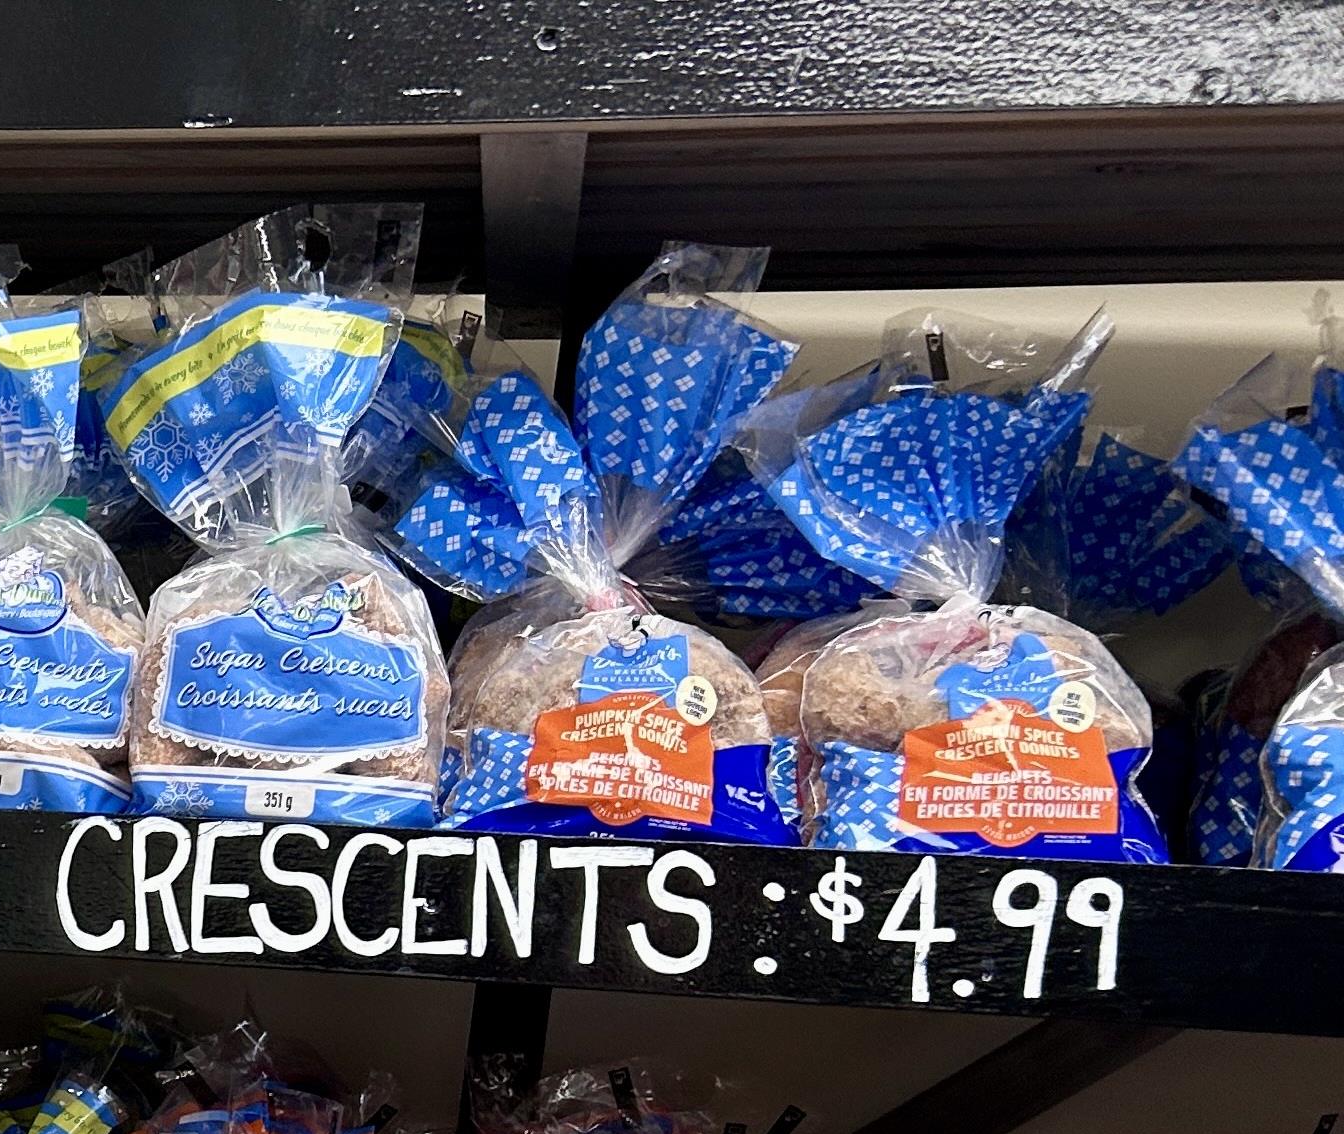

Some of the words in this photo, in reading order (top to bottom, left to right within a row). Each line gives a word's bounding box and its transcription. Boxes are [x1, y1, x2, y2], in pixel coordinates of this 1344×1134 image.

[190, 640, 267, 677] Sugar
[278, 646, 401, 685] Crescents
[38, 690, 115, 719] sucrés
[177, 681, 322, 715] Croissants
[335, 693, 414, 721] sucrés
[575, 709, 642, 730] PUMPKIN
[645, 713, 686, 737] SPICE
[1023, 727, 1065, 746] SPICE
[560, 723, 634, 743] CRESCENT
[637, 728, 688, 754] DONUTS
[934, 740, 1015, 762] CRESCENT
[1018, 742, 1081, 761] DONUTS
[593, 782, 614, 798] DE
[617, 783, 701, 812] CITROUILLE
[634, 767, 712, 799] CROISSANT
[904, 786, 928, 803] EN
[933, 785, 990, 802] FORME
[996, 785, 1019, 801] DE
[1023, 785, 1115, 803] CROISSANT
[263, 791, 283, 809] 351
[285, 795, 293, 812] g
[916, 800, 977, 820] ÉPICES
[980, 802, 1003, 818] DE
[1006, 801, 1102, 820] CITROUILLE
[807, 855, 1125, 1003] $4.99
